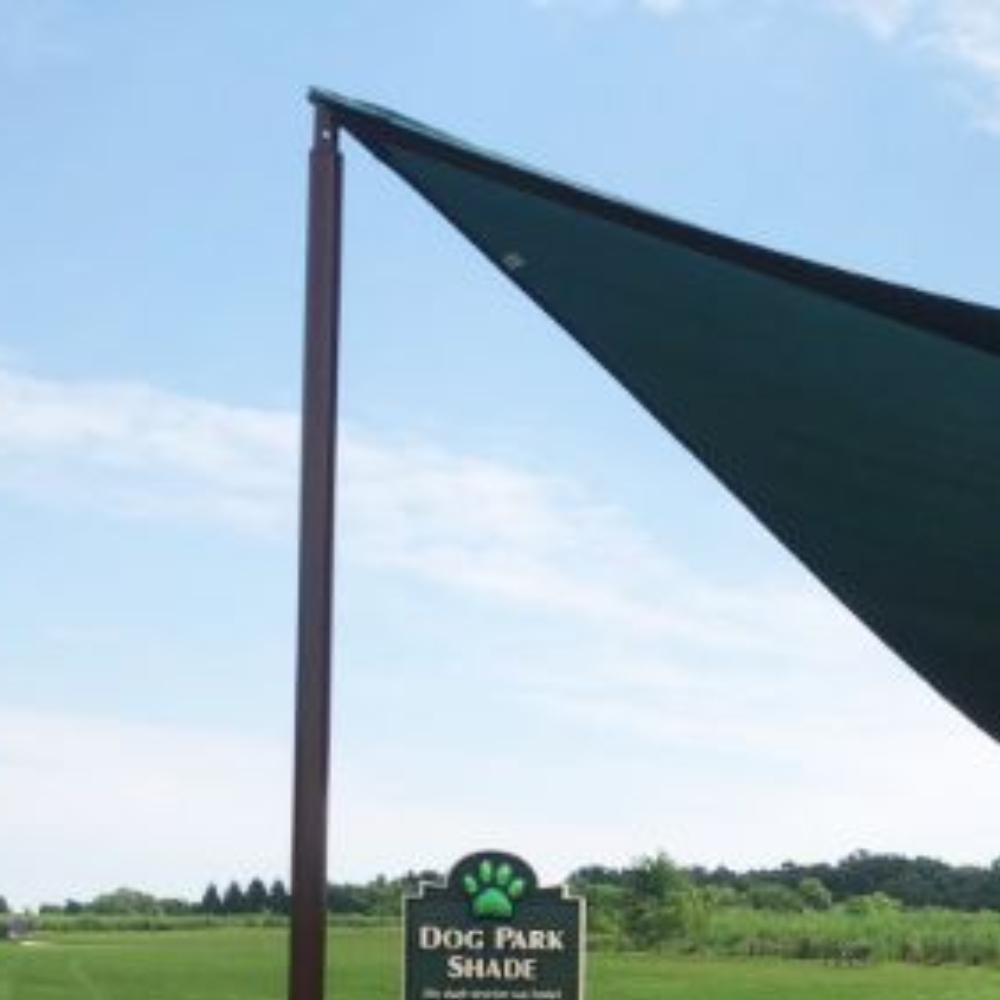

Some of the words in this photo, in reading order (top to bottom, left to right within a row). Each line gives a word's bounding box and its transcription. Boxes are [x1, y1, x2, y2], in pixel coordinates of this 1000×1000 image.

[418, 926, 484, 950] DOG
[495, 927, 565, 950] PARK
[447, 955, 538, 979] SHADE
